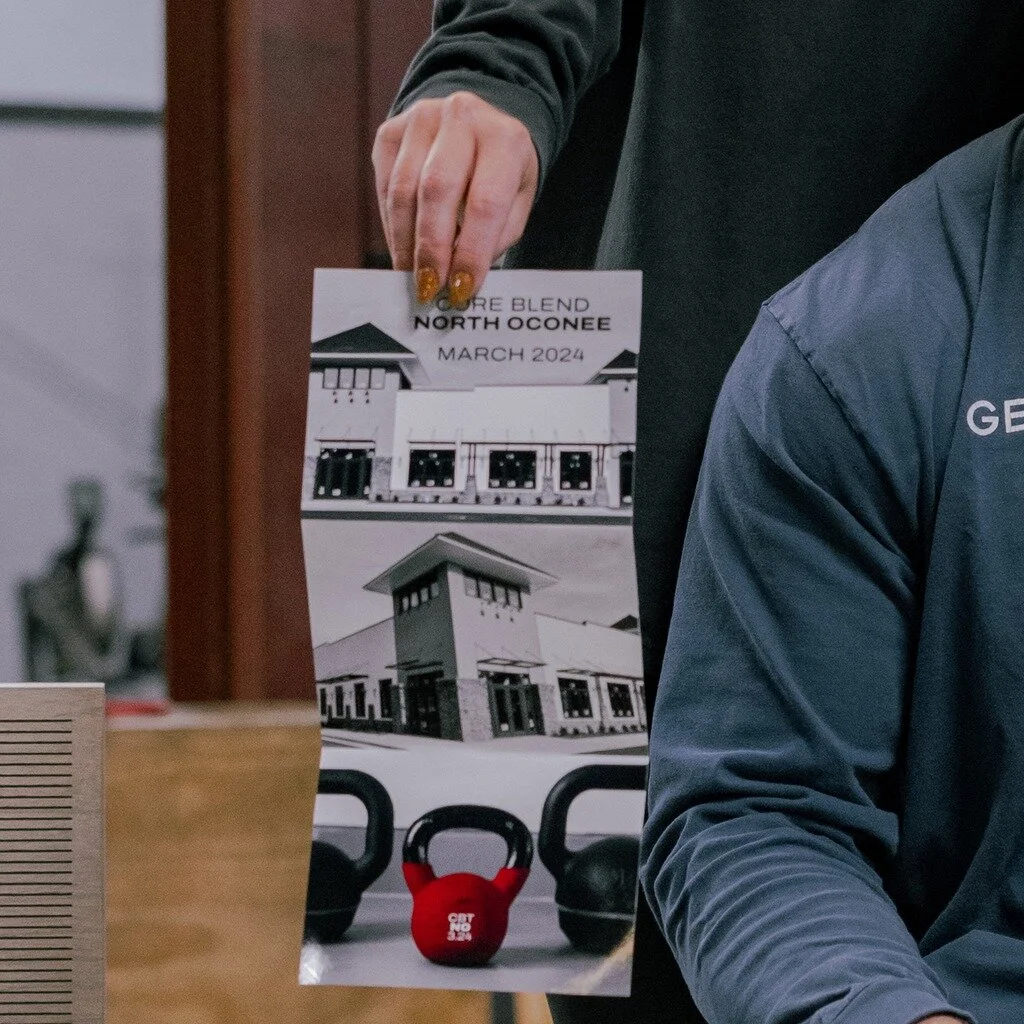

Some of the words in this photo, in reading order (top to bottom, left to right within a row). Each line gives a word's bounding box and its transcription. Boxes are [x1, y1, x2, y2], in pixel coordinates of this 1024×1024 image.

[511, 297, 590, 312] BLEND
[413, 316, 500, 330] NORTH
[507, 316, 611, 331] OCONEE
[438, 346, 524, 362] MARCH
[532, 347, 584, 362] 2024
